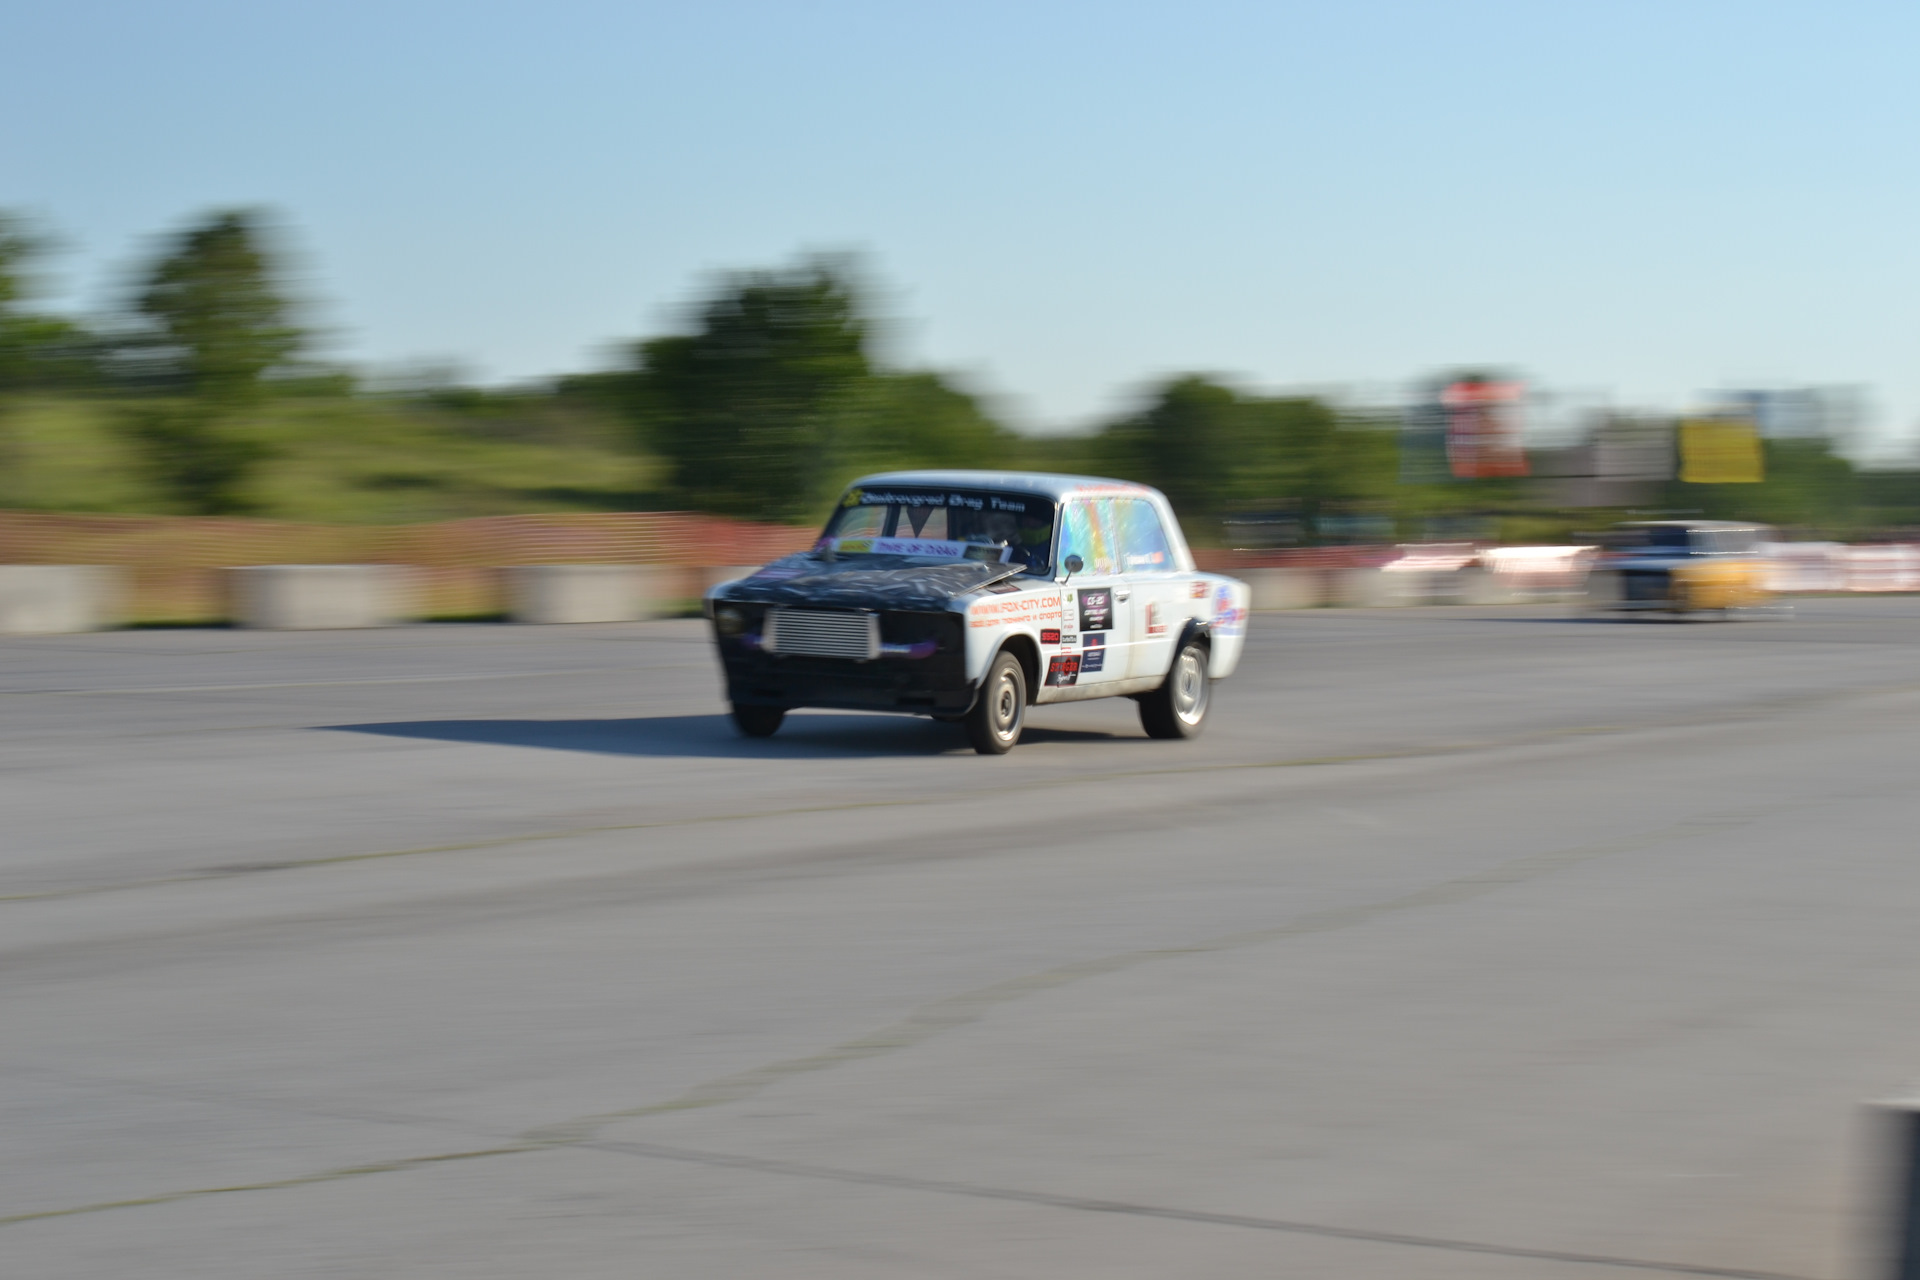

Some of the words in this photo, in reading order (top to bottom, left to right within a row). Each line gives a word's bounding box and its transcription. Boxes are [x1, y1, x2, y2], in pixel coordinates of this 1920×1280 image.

[949, 493, 984, 510] Drag
[991, 496, 1026, 513] Team
[1041, 632, 1059, 641] SS20
